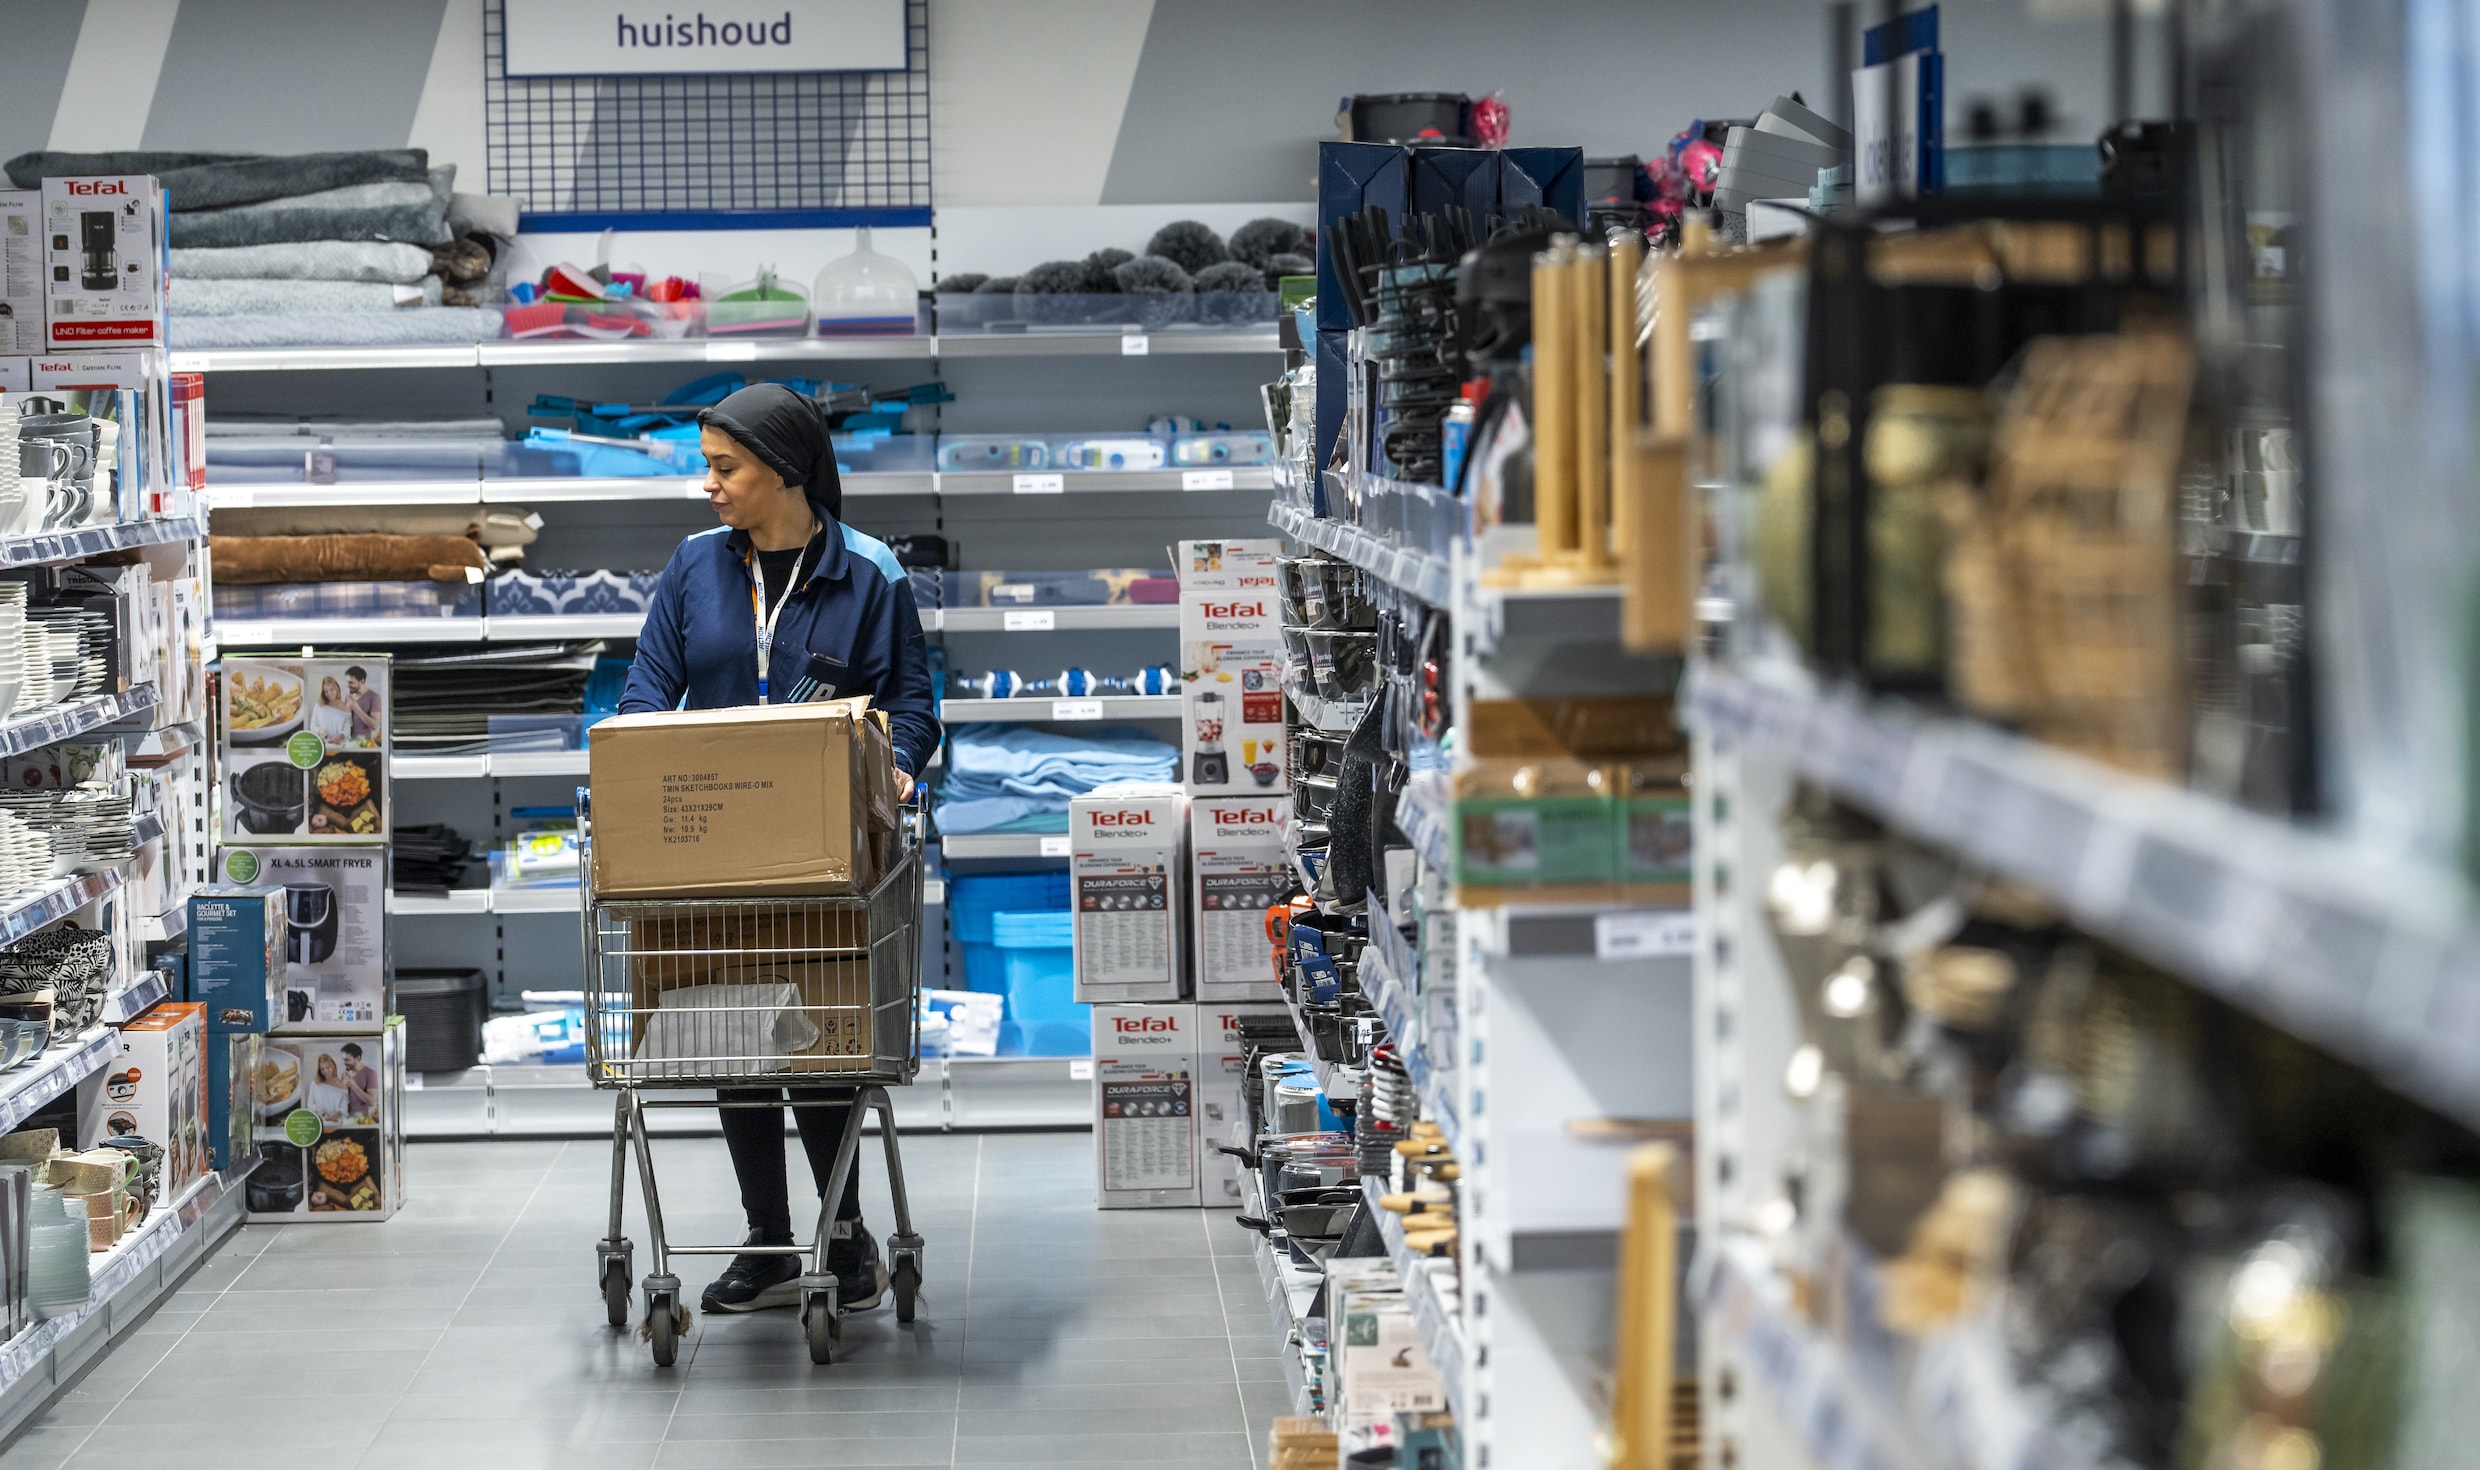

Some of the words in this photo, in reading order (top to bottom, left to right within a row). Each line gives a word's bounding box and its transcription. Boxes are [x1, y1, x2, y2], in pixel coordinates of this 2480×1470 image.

[617, 12, 792, 47] huishoud
[64, 180, 129, 196] Tefal
[55, 327, 75, 336] UNO
[75, 326, 97, 335] Filter
[97, 326, 122, 335] coffee
[123, 325, 149, 334] maker
[38, 363, 73, 372] Tefal
[1237, 577, 1276, 587] Tefal
[1199, 602, 1268, 618] Tefal
[1206, 621, 1261, 631] Blendeo+
[662, 775, 676, 783] ART
[691, 773, 719, 782] 3004857
[680, 783, 733, 792] SKETCHBOOKS
[734, 781, 760, 790] WIRE-O
[761, 781, 774, 789] MIX
[662, 795, 683, 804] 24pcs
[663, 805, 680, 814] Size:
[681, 815, 695, 823] 11.4
[699, 815, 708, 823] kg
[1087, 810, 1156, 826] Tefal
[1209, 808, 1275, 824] Tefal
[681, 825, 695, 833] 10.9
[699, 825, 708, 834] kg
[1094, 829, 1148, 838] Blendeo+
[1216, 828, 1271, 837] Blendeo+
[271, 858, 283, 868] XL
[285, 858, 306, 869] 4.5L
[307, 858, 341, 868] SMART
[343, 858, 372, 869] FRYER
[1083, 879, 1147, 888] DURAFORCE
[1206, 877, 1270, 887] DURAFORCE
[196, 909, 225, 917] GOURMET
[225, 909, 237, 917] SET
[1111, 1016, 1180, 1032] Tefal
[1118, 1036, 1173, 1045] Blendeo+
[1107, 1085, 1171, 1095] DURAFORCE
